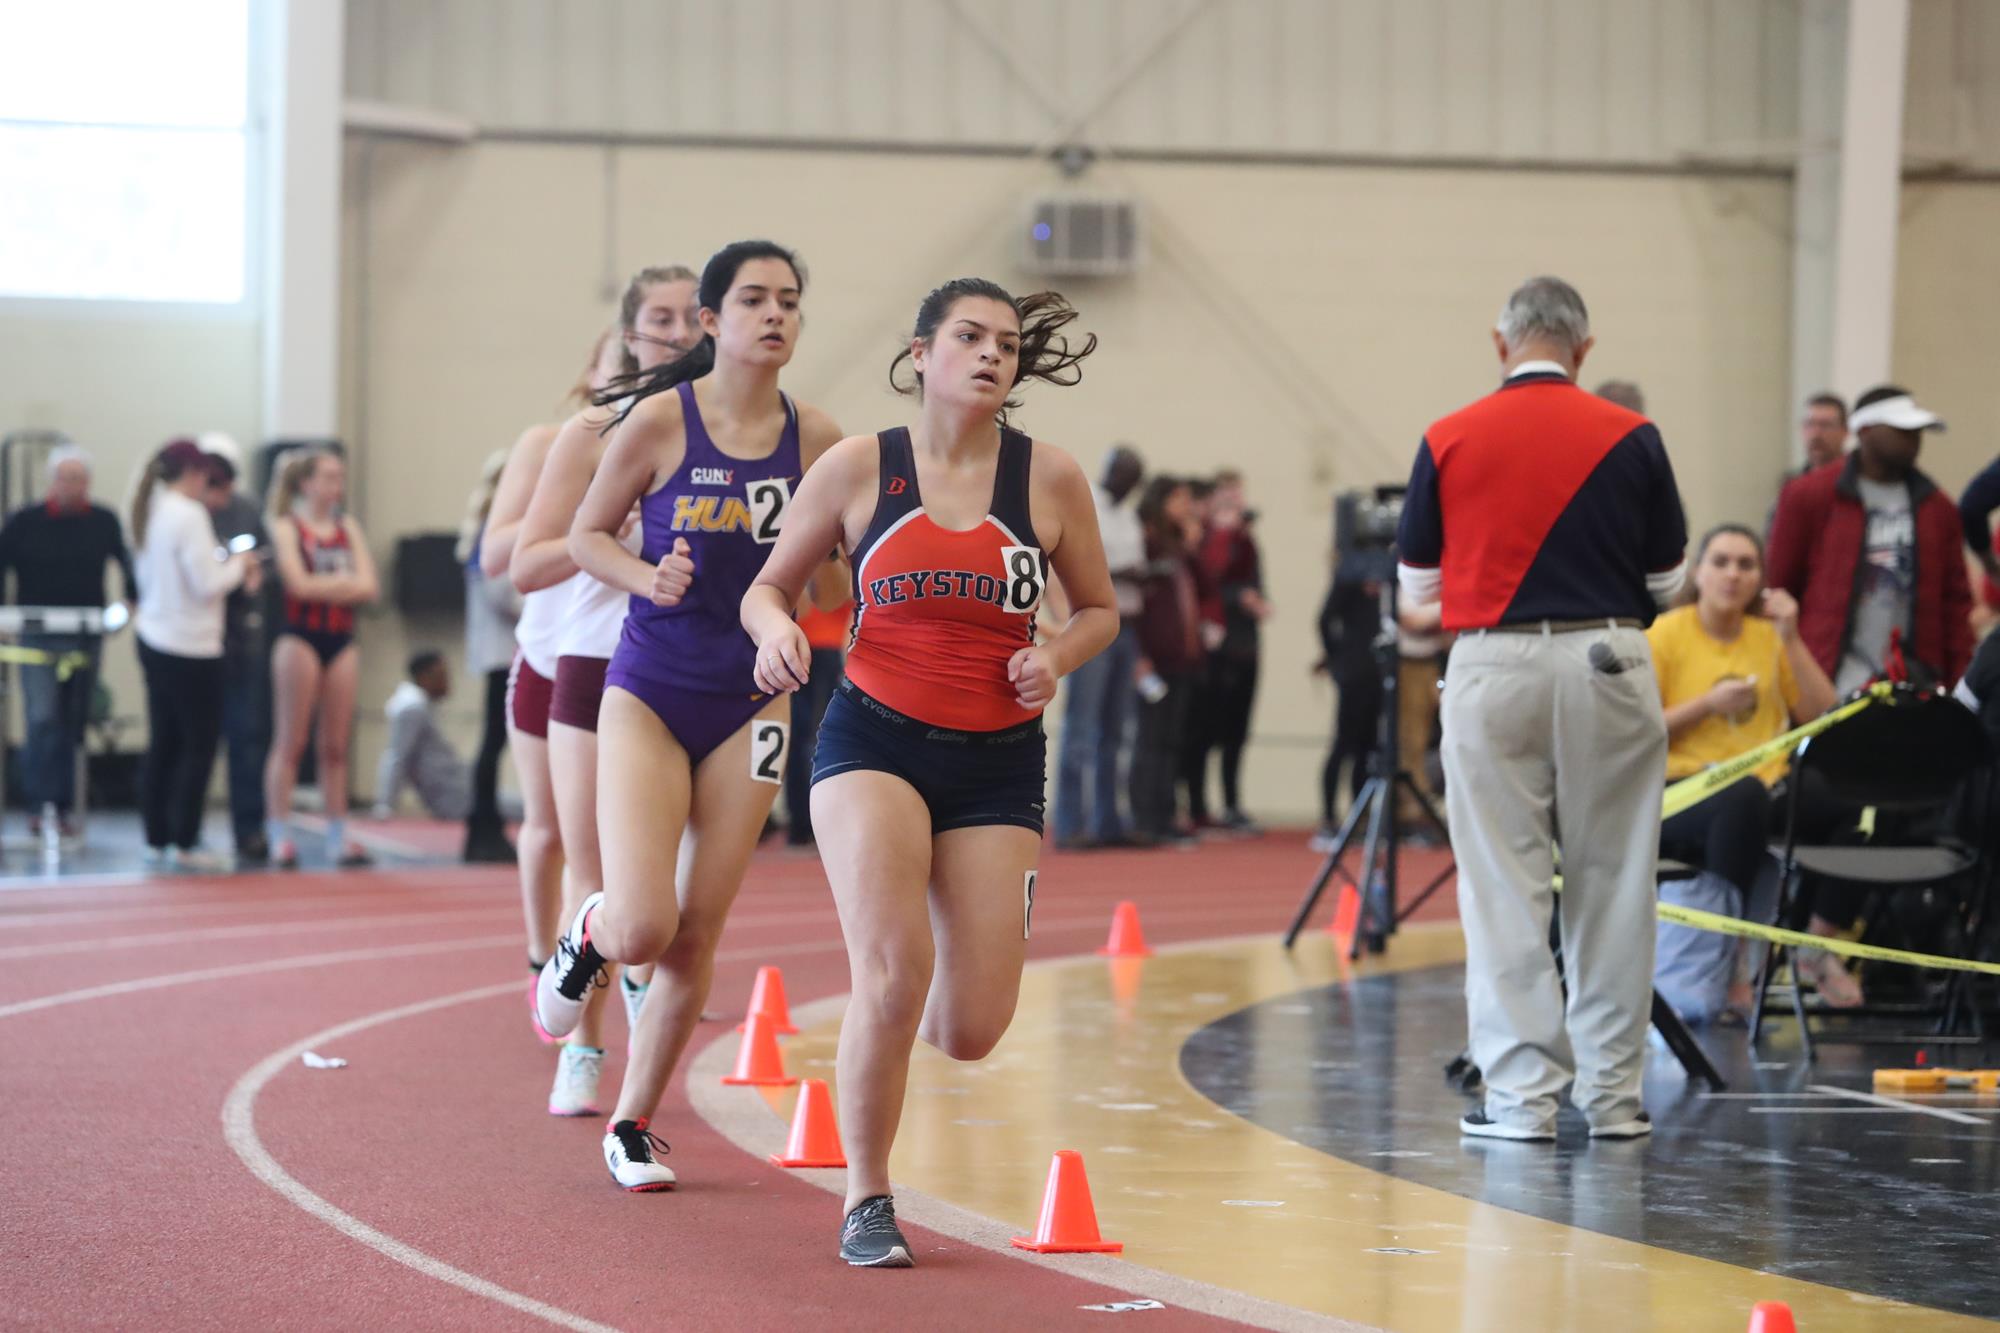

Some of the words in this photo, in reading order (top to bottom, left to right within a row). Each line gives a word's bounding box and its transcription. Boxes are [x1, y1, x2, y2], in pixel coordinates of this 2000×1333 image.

[690, 467, 734, 485] CUNY
[754, 484, 784, 540] 2
[1010, 550, 1040, 610] 8
[861, 696, 907, 726] evapor
[756, 725, 785, 779] 2
